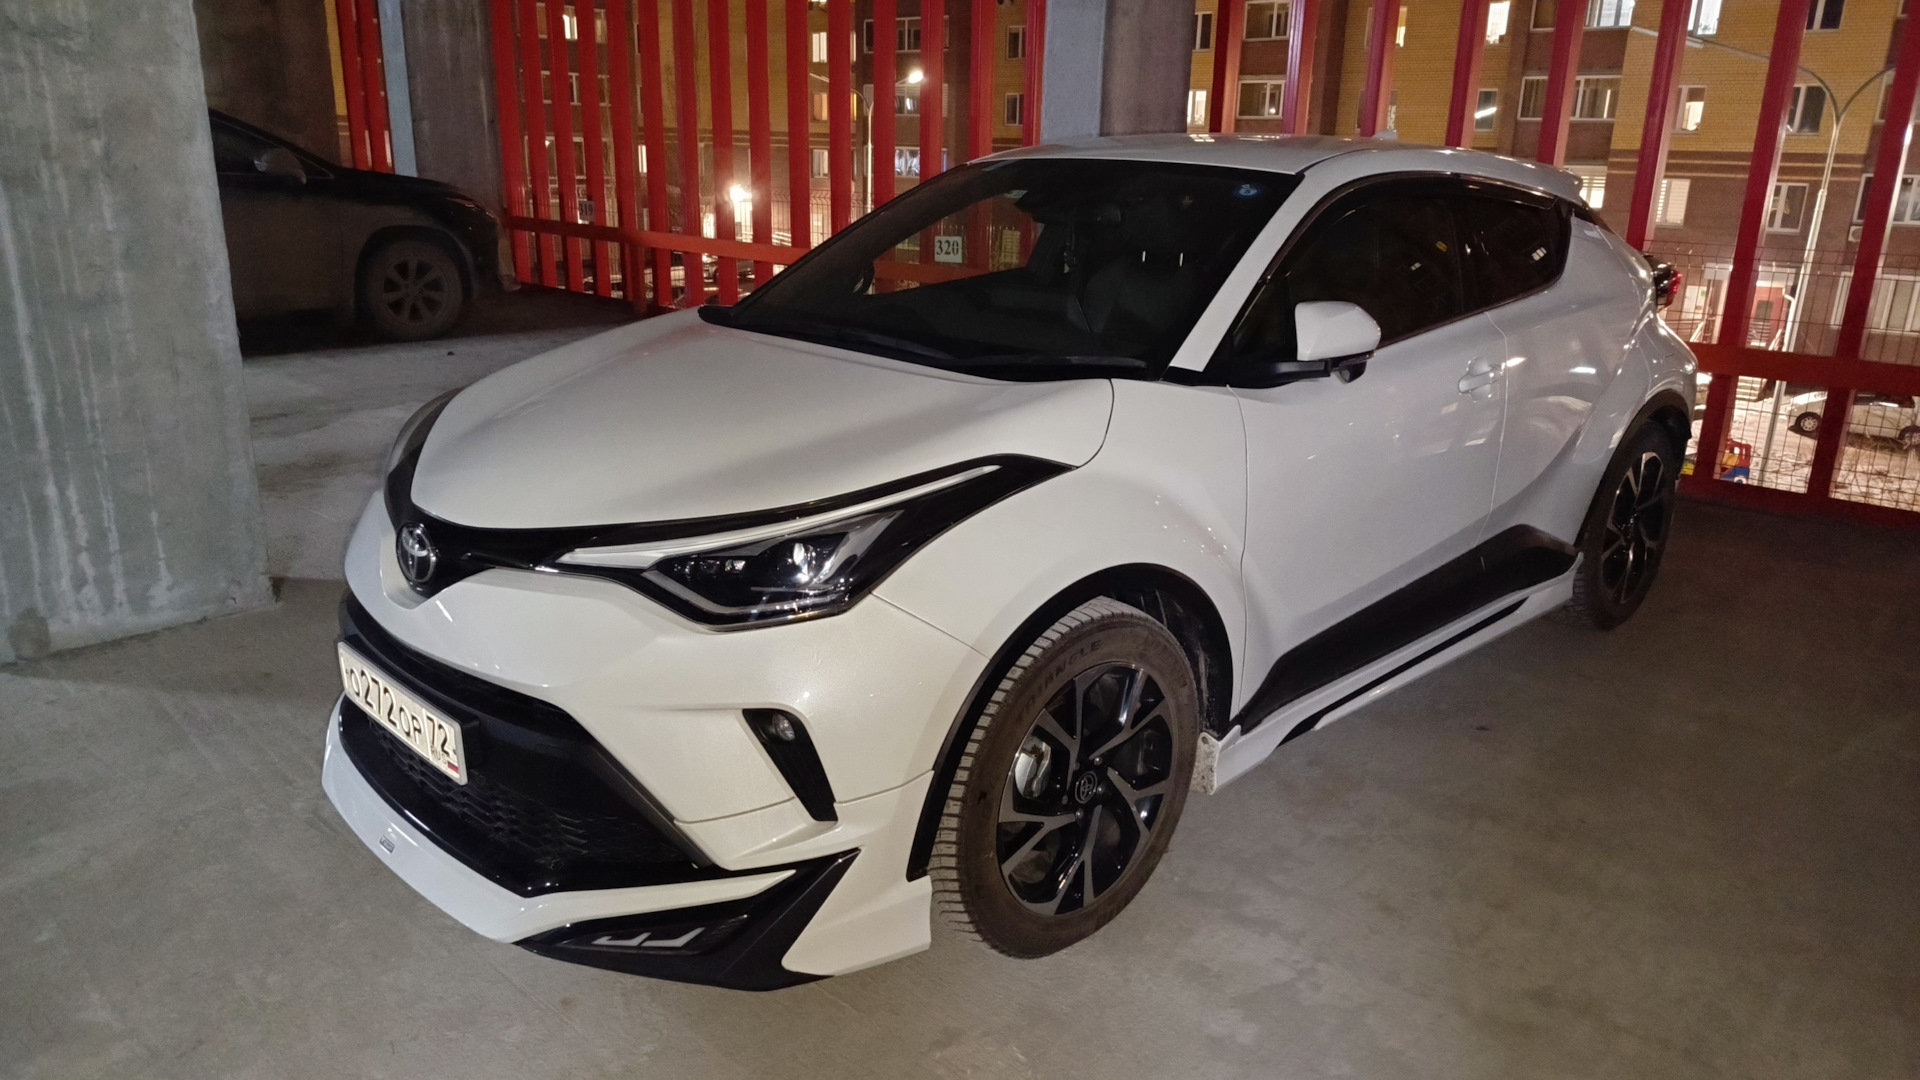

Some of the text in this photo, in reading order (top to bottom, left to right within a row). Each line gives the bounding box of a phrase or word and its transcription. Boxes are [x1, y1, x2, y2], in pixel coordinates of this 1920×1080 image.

[936, 239, 959, 257] 320
[426, 714, 452, 756] 72
[430, 745, 448, 765] RUS
